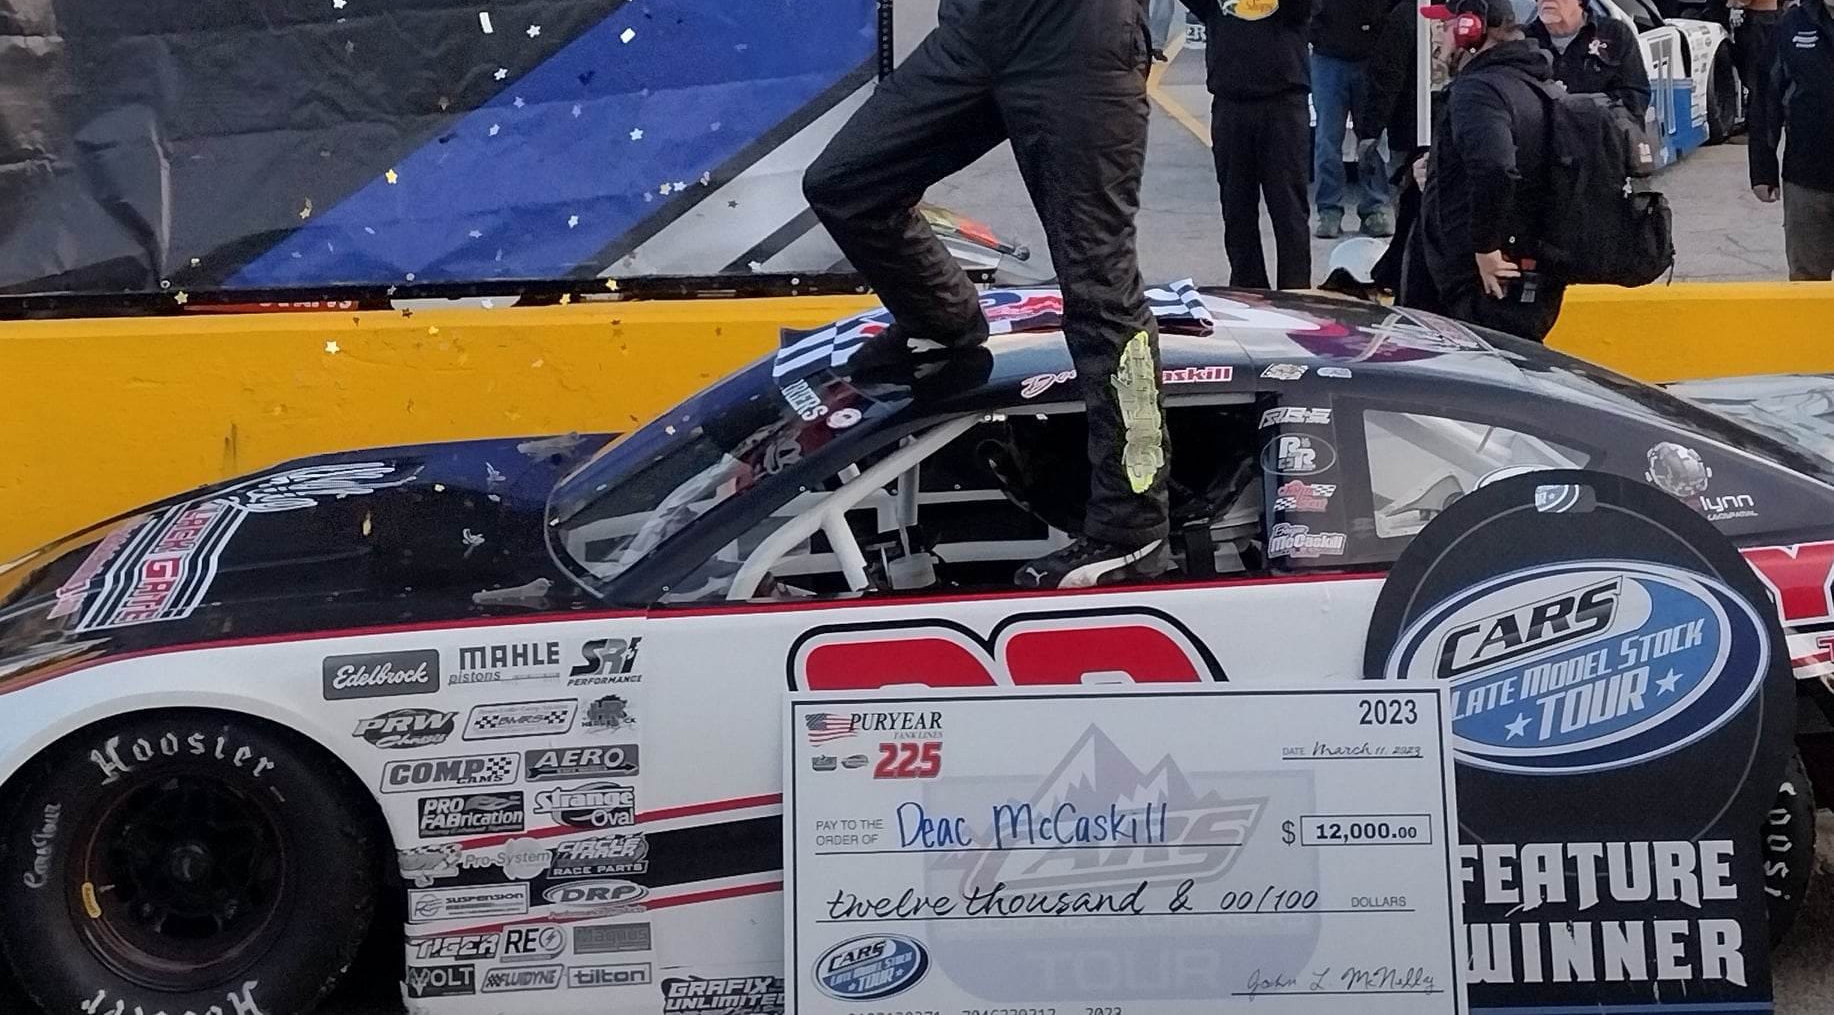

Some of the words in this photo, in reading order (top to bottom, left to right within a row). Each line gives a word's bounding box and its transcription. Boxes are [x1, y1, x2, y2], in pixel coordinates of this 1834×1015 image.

[1161, 366, 1233, 383] askill
[1437, 577, 1622, 678] CARS
[459, 641, 560, 671] MAHLE
[333, 662, 429, 690] Edelbrock
[449, 671, 501, 685] pistons
[567, 675, 643, 687] PERFORMANCE
[1452, 687, 1517, 721] LATE
[1520, 652, 1612, 701] MODEL
[1618, 619, 1705, 669] STOCK
[1359, 699, 1418, 725] 2023
[1536, 666, 1650, 742] TOUR
[352, 711, 459, 737] PRW
[850, 712, 943, 732] PURYEAR
[90, 732, 276, 785] Hoosier
[534, 747, 625, 769] AERO
[873, 741, 944, 780] 225
[1282, 746, 1305, 756] DATE
[1312, 741, 1372, 756] March
[389, 758, 485, 785] COMP
[456, 774, 504, 785] CAMS
[424, 797, 465, 815] PRO
[534, 788, 634, 813] Strange
[420, 809, 524, 830] FABrication
[591, 807, 634, 827] Oval
[816, 820, 837, 831] PAY
[839, 820, 857, 831] TO
[861, 819, 883, 830] THE
[897, 801, 972, 848] Deac
[993, 801, 1167, 849] McCaskill
[816, 835, 859, 846] ORDER
[862, 834, 879, 845] OF
[1282, 820, 1296, 846] $
[1315, 822, 1417, 843] 12,000.00
[465, 851, 551, 866] Pro-System
[553, 867, 592, 876] RACE
[597, 864, 642, 873] PARTS
[1458, 839, 1738, 911] FEATURE
[560, 886, 637, 902] DRP
[827, 888, 956, 919] twelve
[962, 880, 1148, 917] thousand
[1168, 878, 1194, 913] &
[1220, 885, 1319, 913] 00/100
[1351, 896, 1407, 908] DOLLARS
[409, 934, 500, 959] TIGER
[827, 940, 888, 973] CARS
[1464, 918, 1748, 987] WINNER
[409, 967, 475, 996] VOLT
[574, 969, 645, 984] tilton
[668, 977, 773, 998] GRAFIX
[857, 966, 896, 992] TOUR
[1247, 968, 1298, 1002] John
